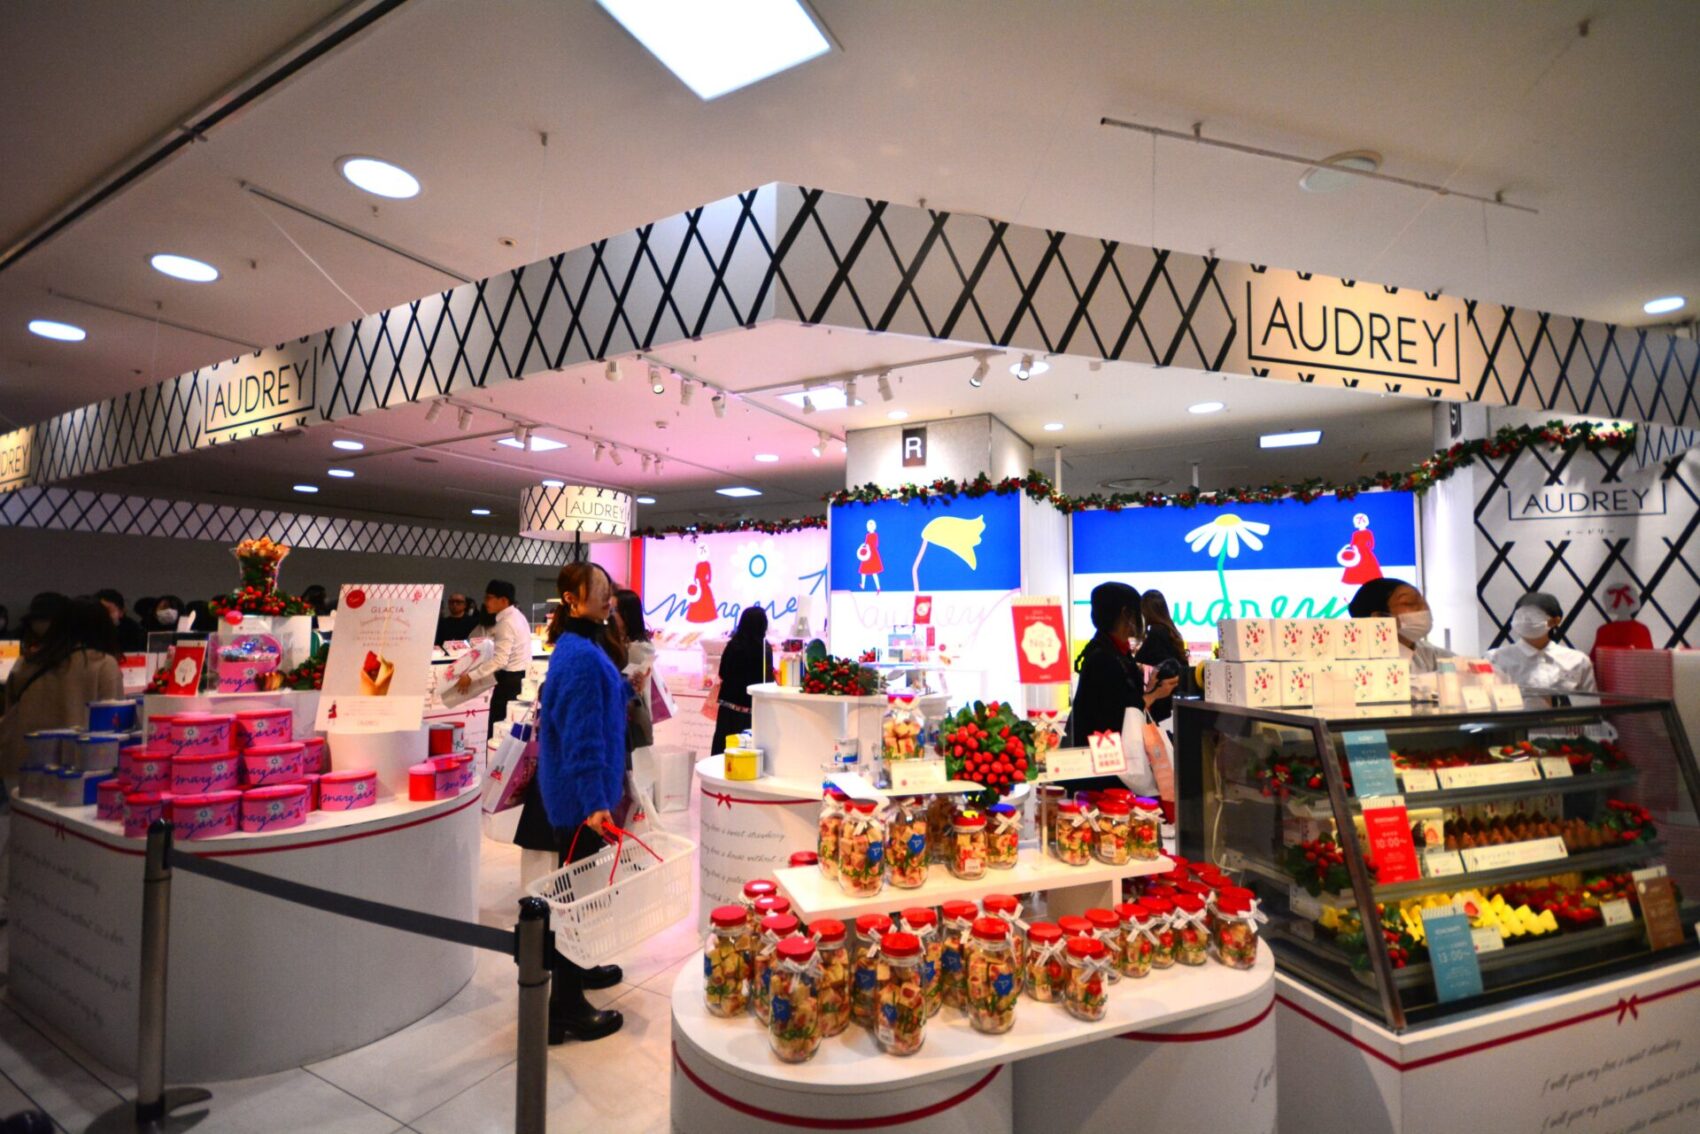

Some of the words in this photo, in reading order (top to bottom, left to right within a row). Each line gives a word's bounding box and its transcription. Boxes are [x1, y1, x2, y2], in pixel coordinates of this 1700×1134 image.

[1262, 296, 1446, 367] AUDREY
[210, 358, 310, 422] AUDREY
[905, 436, 923, 459] R
[571, 500, 625, 519] AUDREY
[1522, 488, 1650, 515] AUDREY
